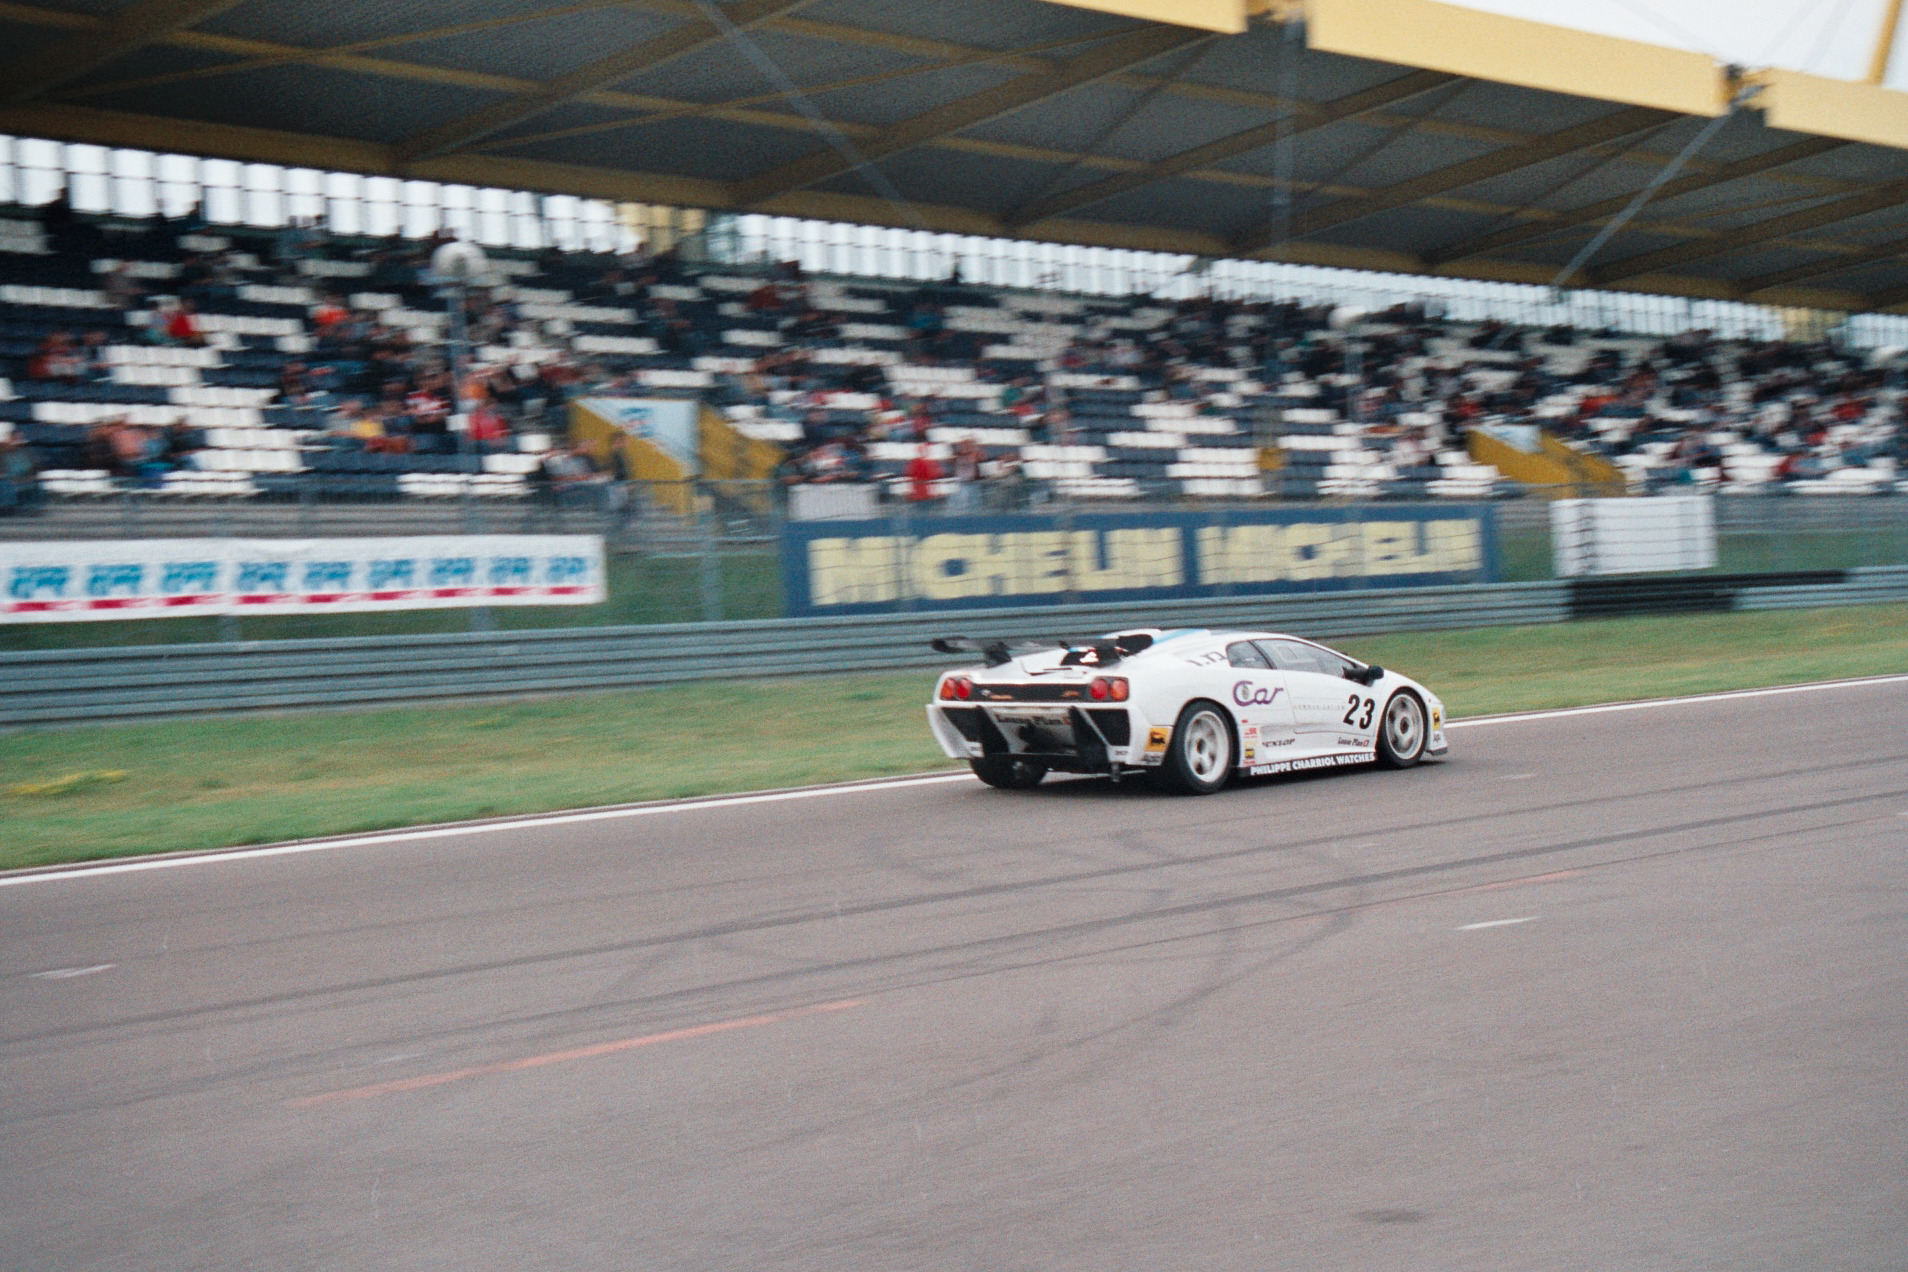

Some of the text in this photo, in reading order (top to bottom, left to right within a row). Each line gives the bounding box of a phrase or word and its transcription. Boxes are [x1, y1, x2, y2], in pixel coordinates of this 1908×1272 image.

[1232, 680, 1284, 707] Car
[1343, 694, 1375, 729] 23
[1251, 763, 1292, 775] PHILIPPE
[1292, 757, 1334, 769] CHARRIOL
[1336, 753, 1375, 764] WATCHES
